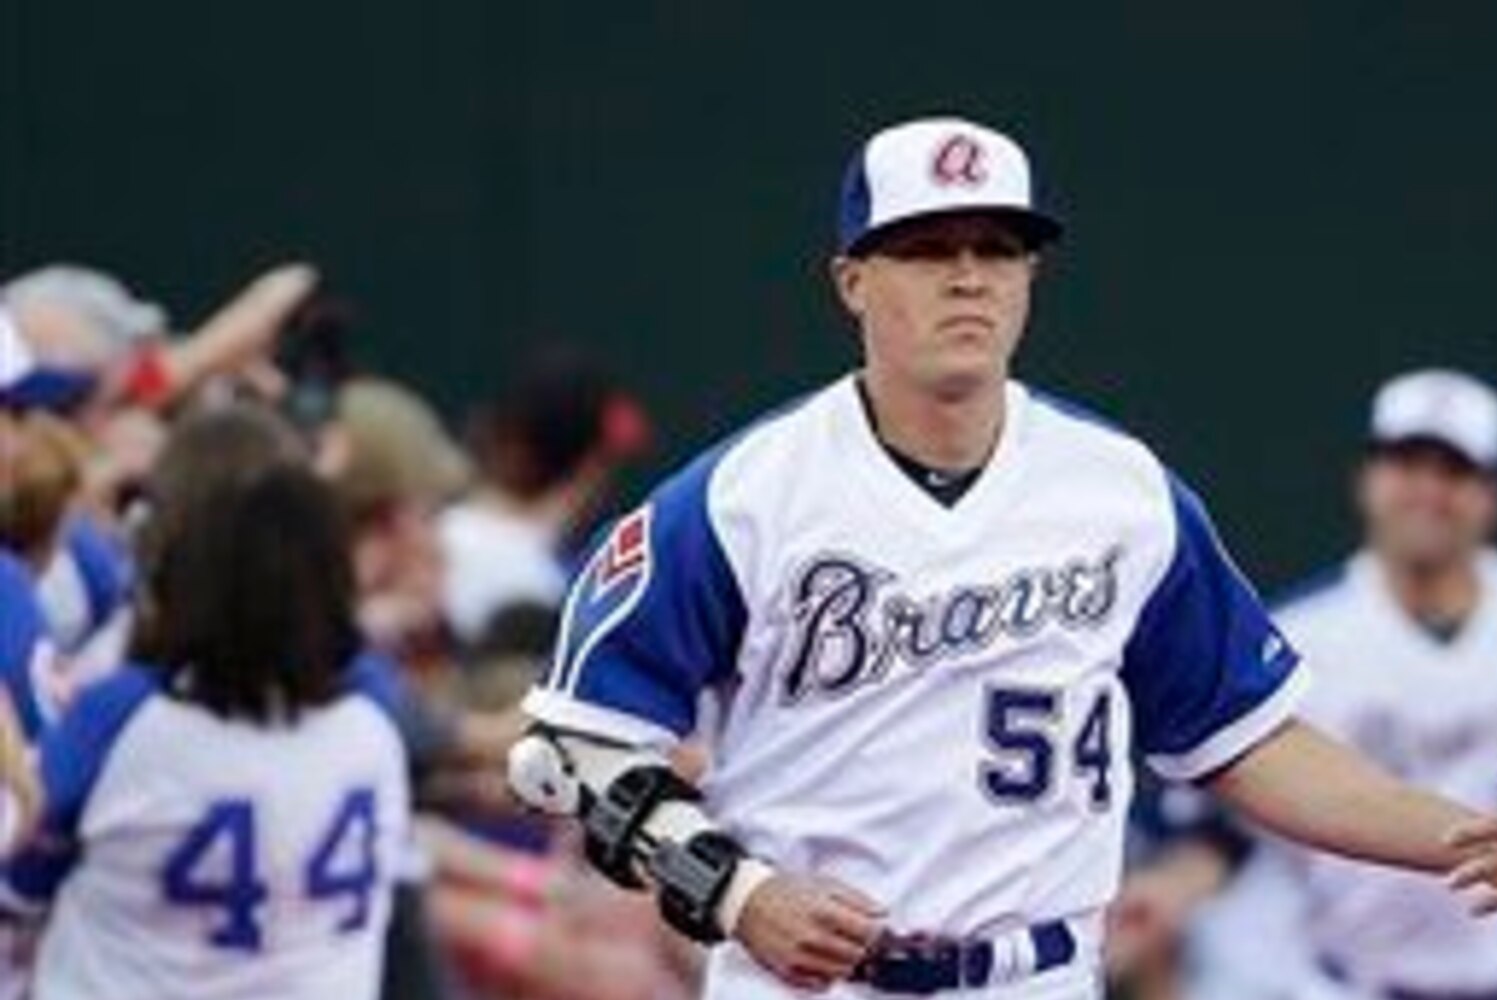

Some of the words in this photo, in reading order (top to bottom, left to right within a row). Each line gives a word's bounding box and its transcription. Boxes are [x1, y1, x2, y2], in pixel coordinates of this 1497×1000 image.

[778, 550, 1122, 706] Braves
[980, 683, 1113, 811] 54
[160, 787, 377, 954] 44
